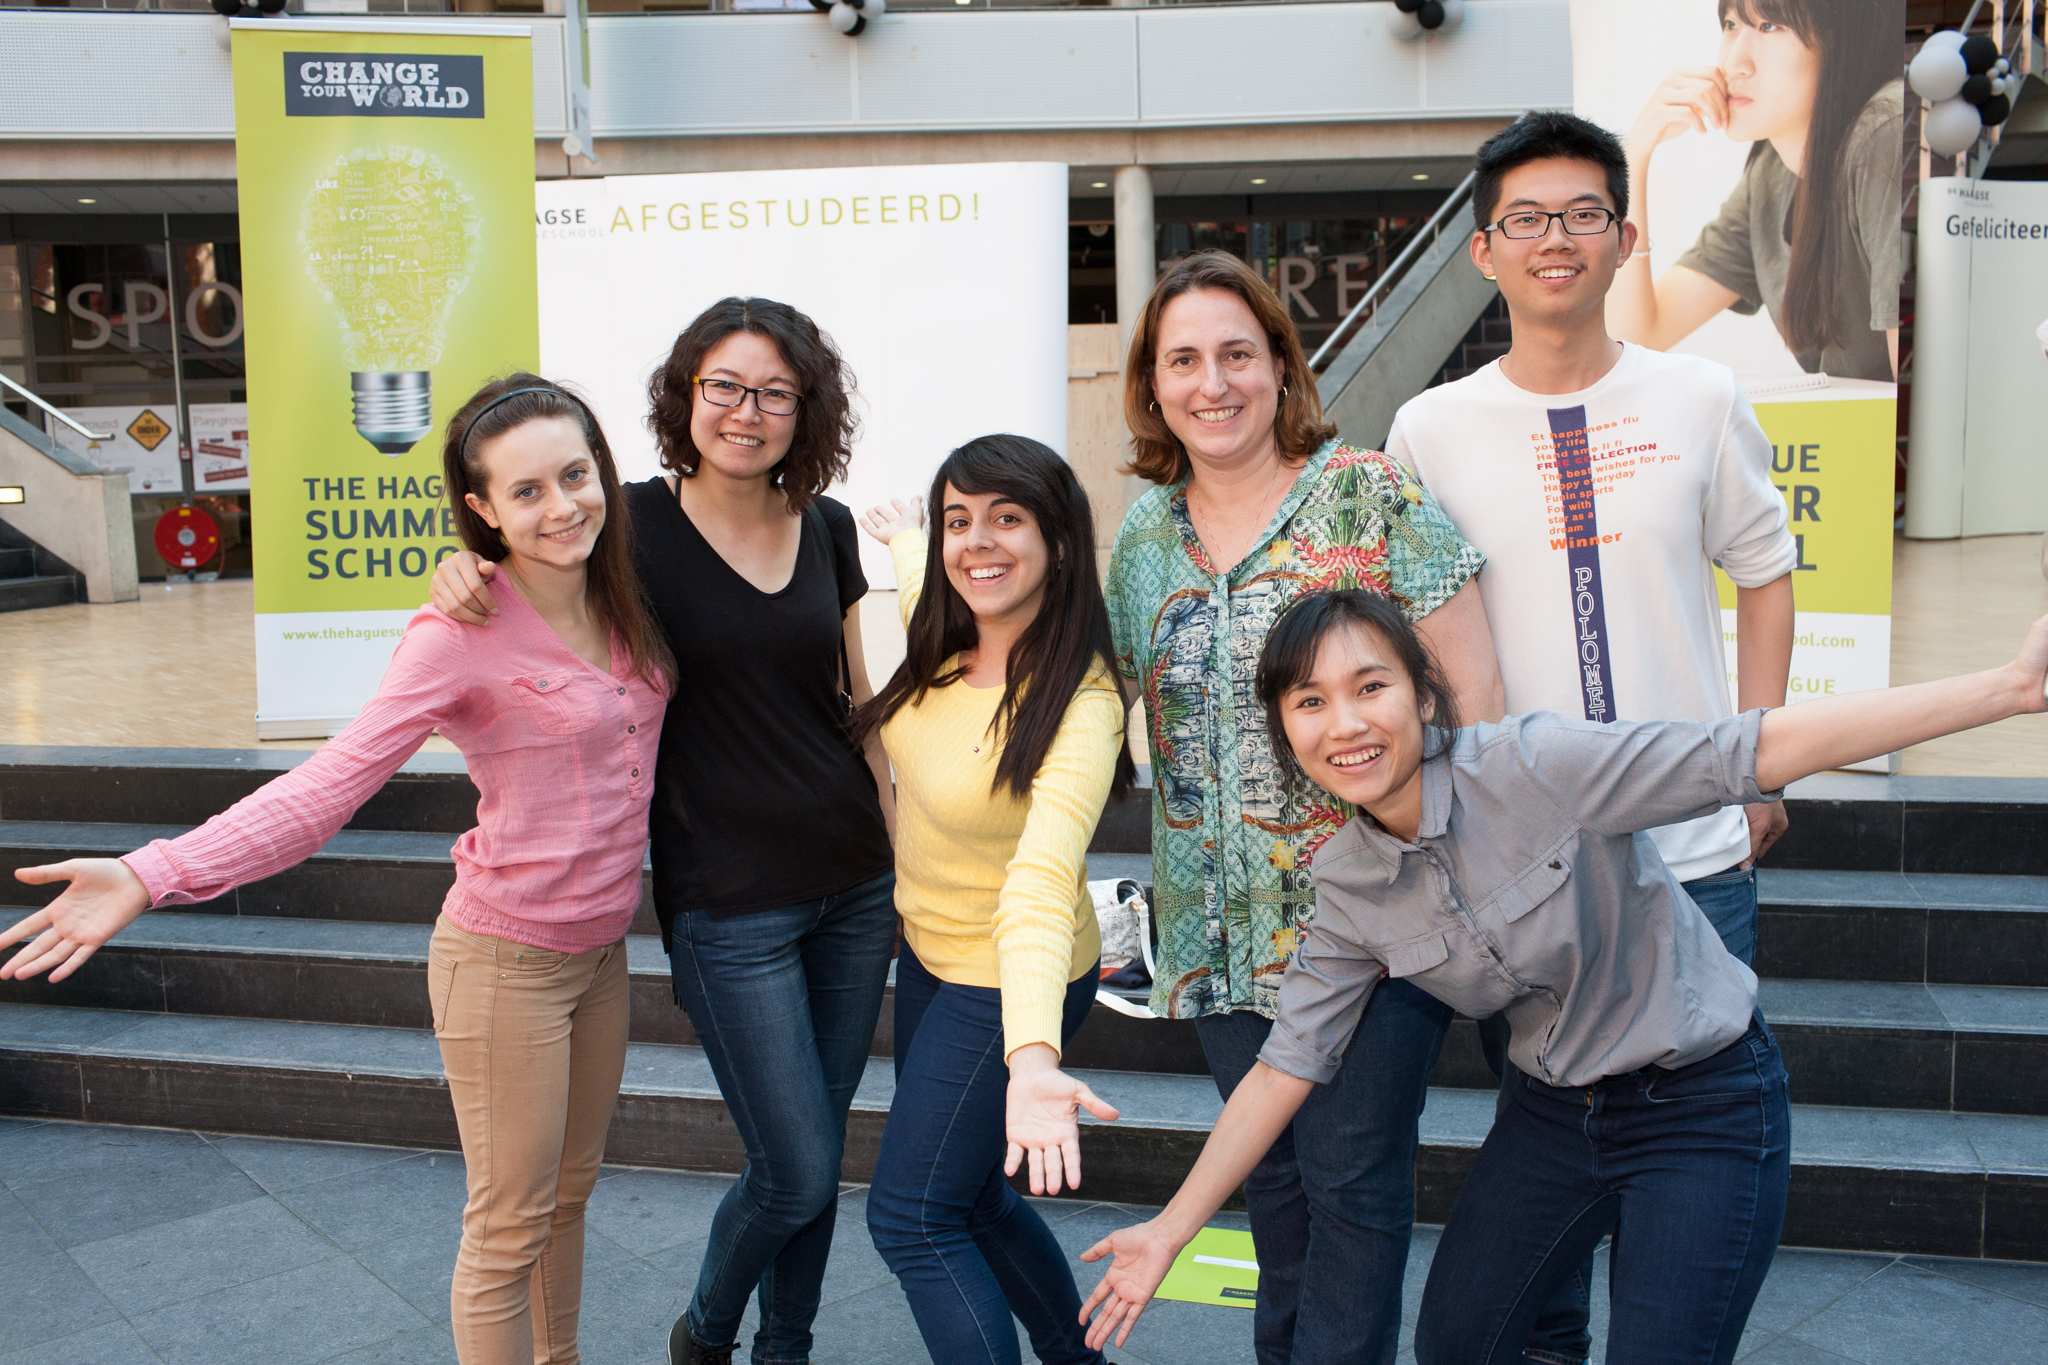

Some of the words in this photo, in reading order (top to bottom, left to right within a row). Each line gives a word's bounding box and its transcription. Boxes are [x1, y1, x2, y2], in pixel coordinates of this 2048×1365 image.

[300, 61, 440, 86] CHANGE
[300, 85, 347, 97] YOUR
[609, 193, 979, 233] AFGESTUDEERD!
[1531, 433, 1545, 441] Et
[1534, 442, 1562, 453] your
[1566, 438, 1586, 447] life
[1536, 450, 1568, 461] Hand
[1572, 446, 1598, 456] sme
[1536, 459, 1570, 470] FREE
[1574, 443, 1657, 465] COLLECTION
[1541, 472, 1563, 482] The
[1566, 466, 1592, 478] best
[1595, 459, 1636, 473] wishes
[1639, 455, 1657, 464] for
[1660, 454, 1681, 464] you
[302, 477, 366, 501] THE
[1543, 480, 1580, 492] Happy
[1583, 469, 1636, 486] everyday
[1545, 492, 1576, 503] Funin
[1579, 485, 1614, 499] sports
[1547, 504, 1566, 514] For
[1568, 500, 1592, 511] with
[1548, 514, 1569, 525] star
[1572, 513, 1585, 521] as
[1587, 511, 1594, 519] a
[1549, 524, 1584, 535] dream
[1550, 532, 1623, 551] Winner
